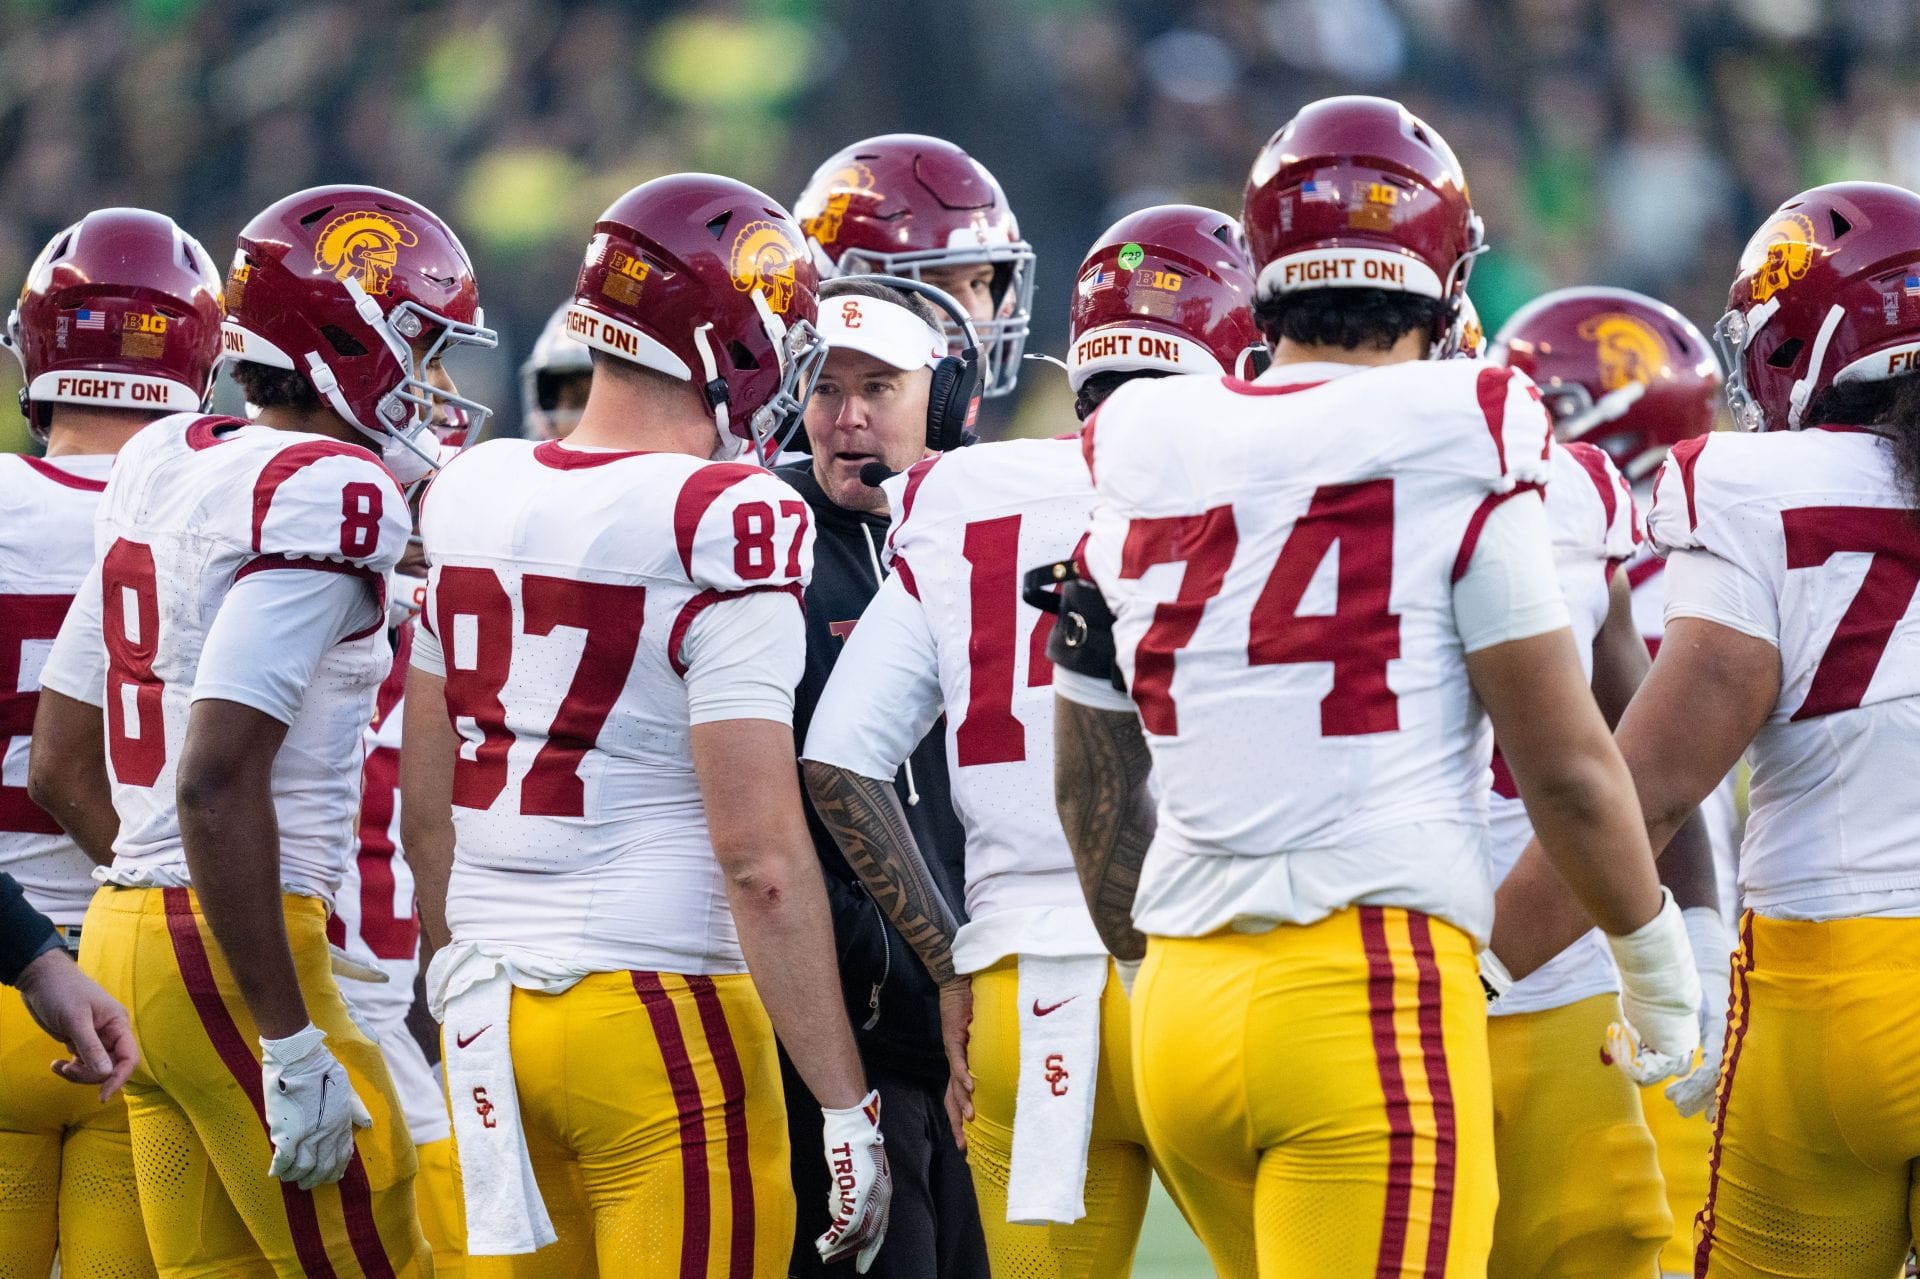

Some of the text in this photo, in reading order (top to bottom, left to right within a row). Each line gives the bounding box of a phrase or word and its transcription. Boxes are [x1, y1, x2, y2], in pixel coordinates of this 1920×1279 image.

[1285, 259, 1405, 285] FIGHT ON!
[224, 331, 245, 353] ON!
[567, 311, 639, 357] FIGHT ON!
[1077, 335, 1180, 365] FIGHT ON!
[57, 378, 168, 403] FIGHT ON!
[341, 482, 383, 558] 8
[733, 501, 808, 580] 87
[1119, 478, 1402, 737] 74
[102, 536, 167, 788] 8
[436, 565, 646, 817] 87
[1045, 1054, 1069, 1097] SC
[473, 1086, 496, 1128] SC
[825, 1142, 857, 1246] TROJANS
